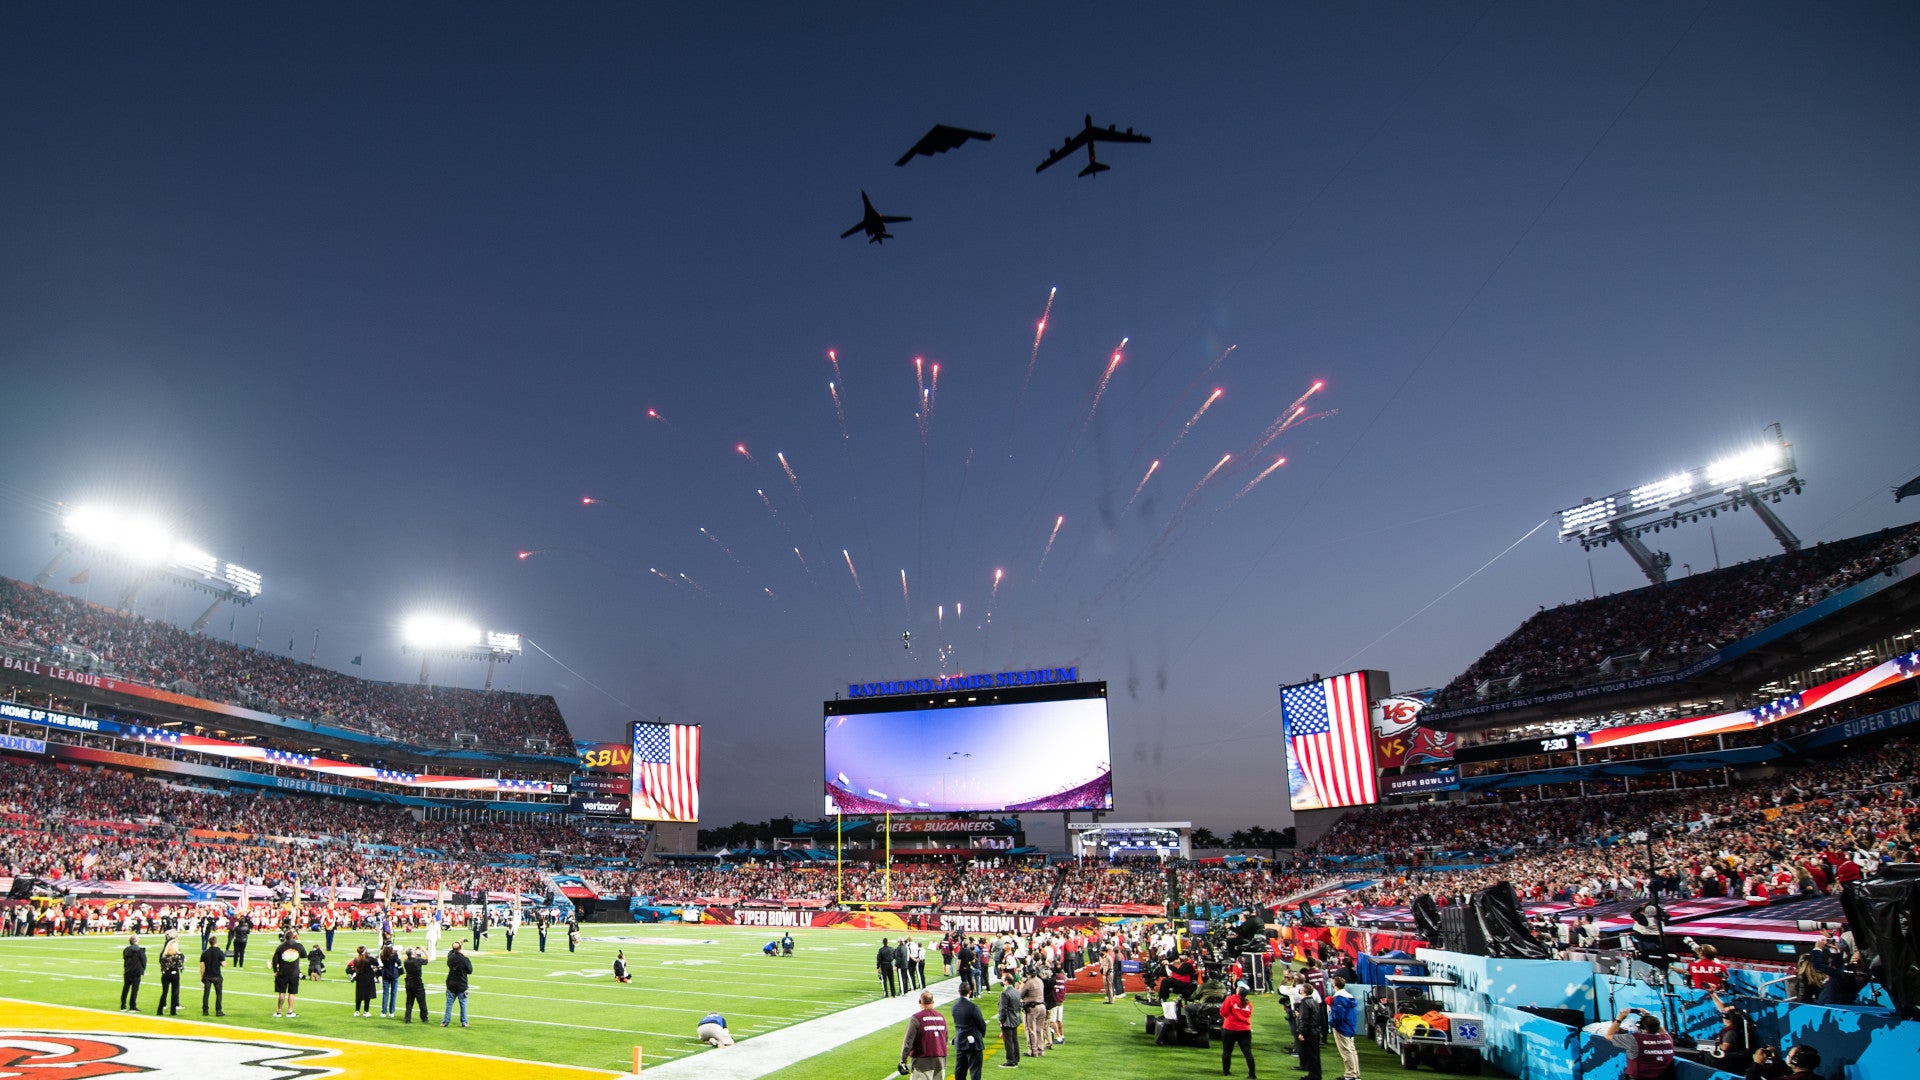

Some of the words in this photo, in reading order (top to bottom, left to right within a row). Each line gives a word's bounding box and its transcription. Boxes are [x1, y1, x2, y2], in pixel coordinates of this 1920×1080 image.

[0, 656, 40, 674] BALL
[49, 667, 101, 687] LEAGUE
[849, 678, 933, 697] RAYMOND
[935, 673, 993, 691] JAMES
[996, 667, 1076, 686] STADIUM
[1421, 714, 1439, 722] NEED
[1441, 706, 1490, 719] ASSISTANCE?
[1491, 702, 1510, 711] TEXT
[1576, 687, 1599, 698] WITH
[1600, 683, 1626, 692] YOUR
[1628, 674, 1674, 689] LOCATION
[1, 704, 30, 719] HOME
[31, 710, 46, 721] OF
[47, 712, 66, 725] THE
[67, 716, 99, 730] BRAVE
[1844, 714, 1885, 737] SUPER
[1541, 738, 1568, 751] 7:30
[585, 748, 632, 768] SBLV
[277, 778, 307, 790] SUPER
[310, 784, 334, 794] BOWL
[337, 788, 347, 796] LV
[1391, 780, 1417, 788] SUPER
[1420, 777, 1442, 786] BOWL
[583, 801, 617, 811] verizon
[875, 822, 912, 833] CHIEFS
[923, 821, 996, 832] BUCCANEERS
[768, 910, 798, 927] BOWL
[800, 911, 813, 927] LV
[940, 915, 980, 932] SUPER
[981, 916, 1017, 933] BOWL
[1018, 917, 1035, 934] LV
